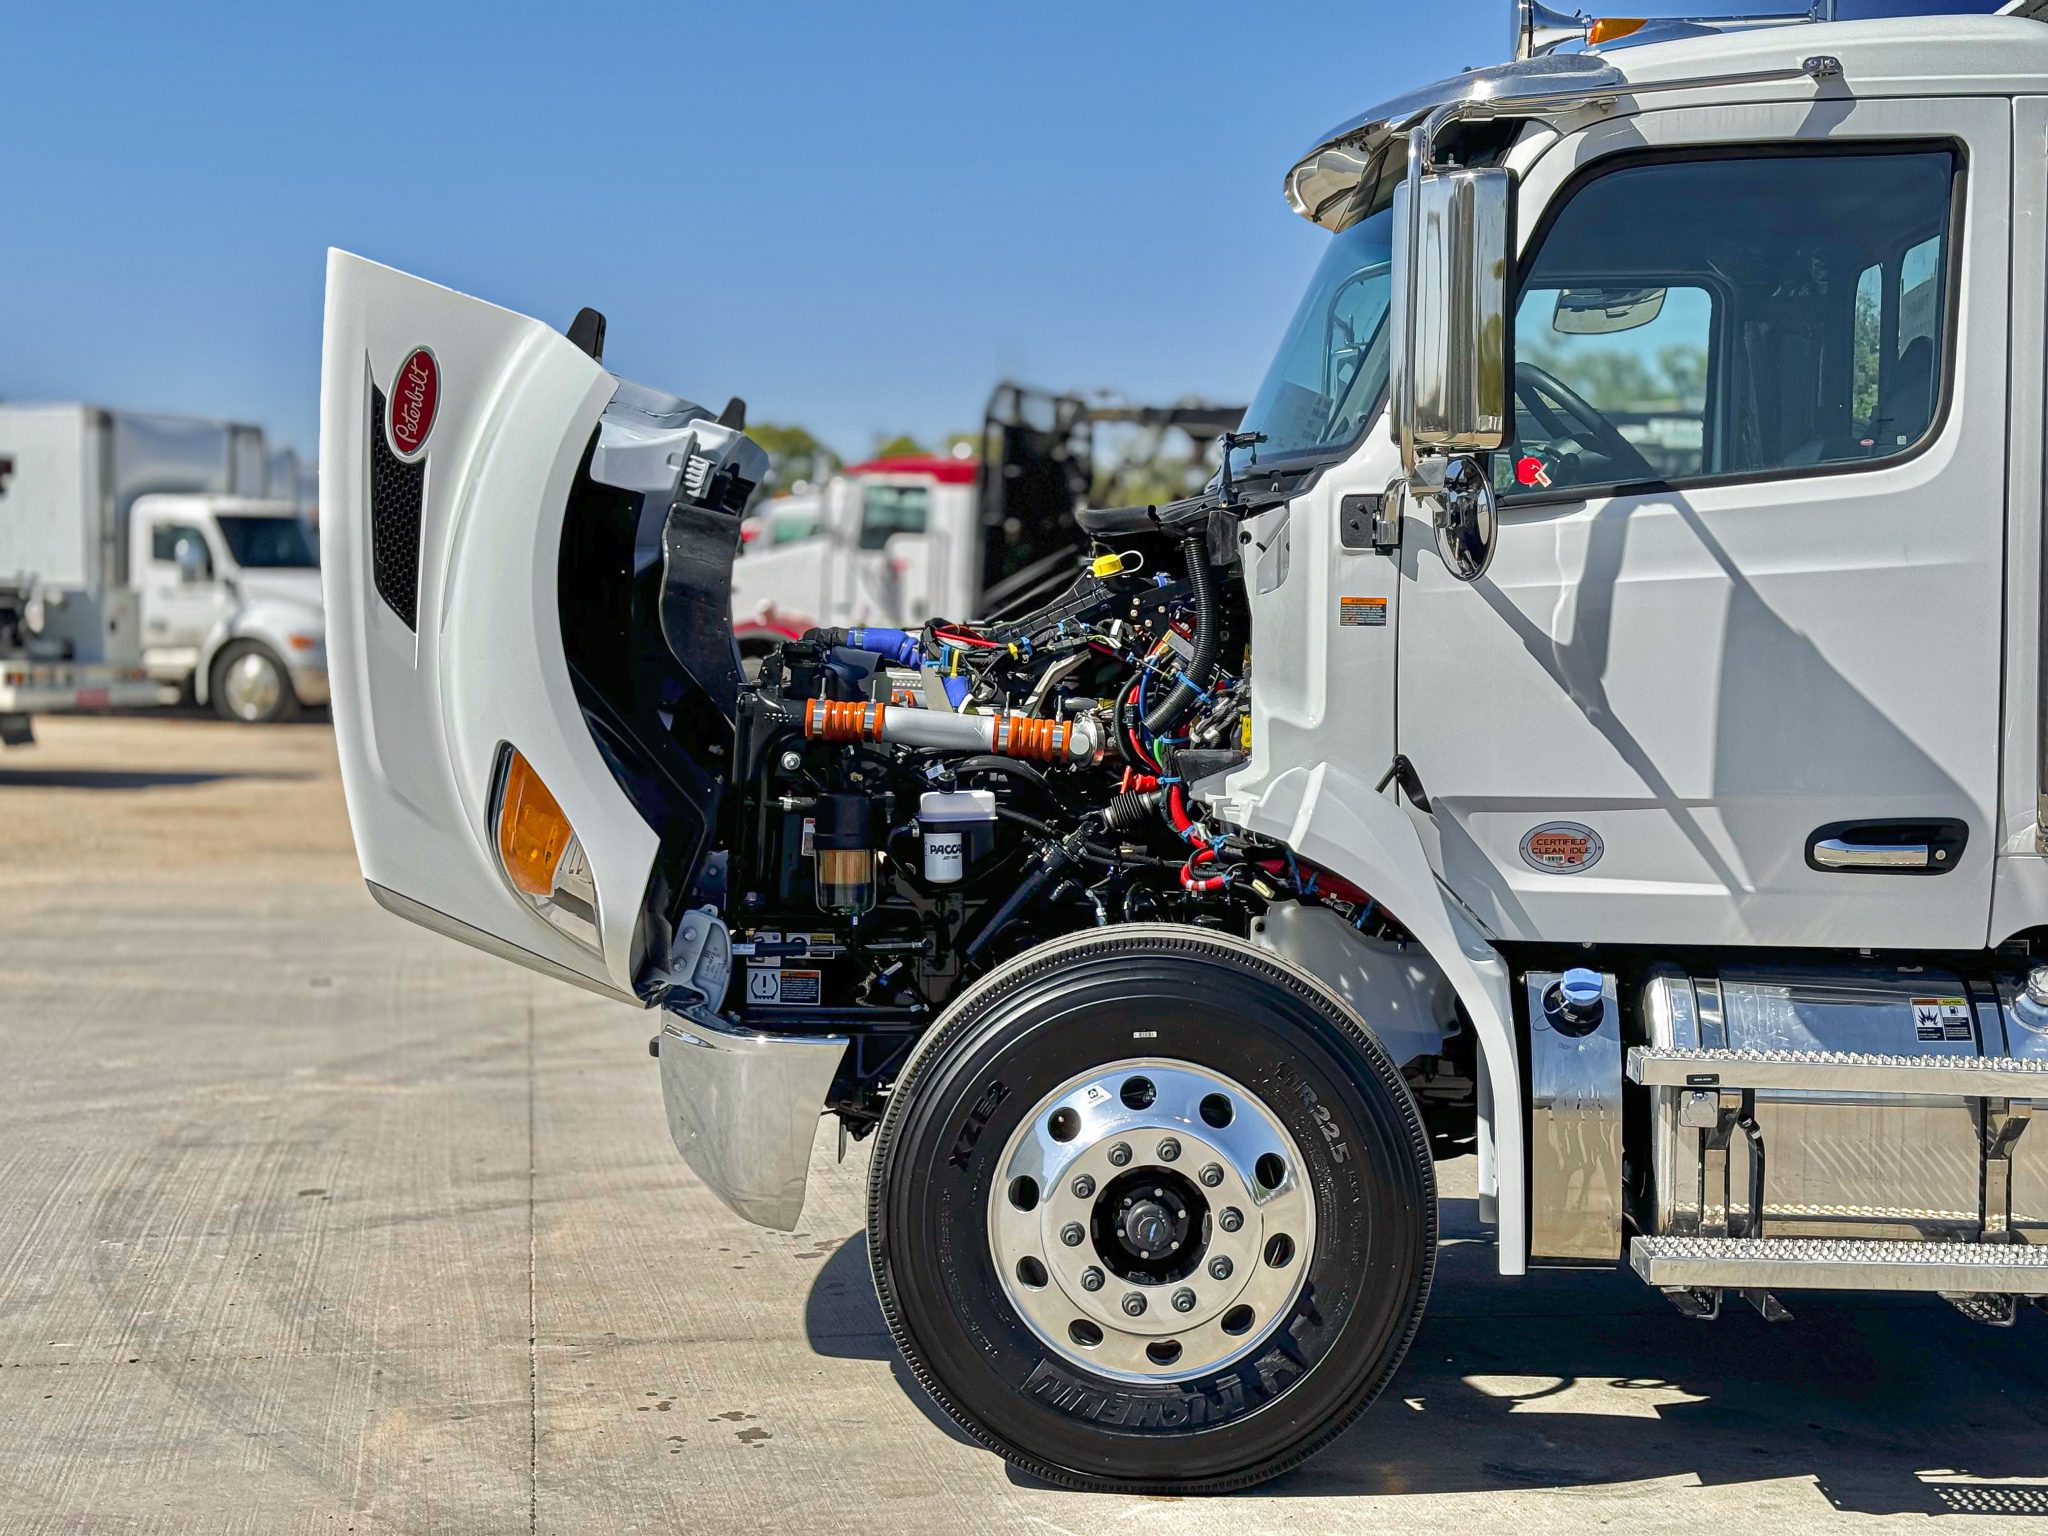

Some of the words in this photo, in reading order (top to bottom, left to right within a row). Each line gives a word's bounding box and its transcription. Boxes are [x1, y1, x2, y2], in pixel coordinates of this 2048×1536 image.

[395, 357, 429, 444] Peterbilt
[1536, 838, 1587, 846] CERTIFIED
[1531, 847, 1565, 855] CLEAN
